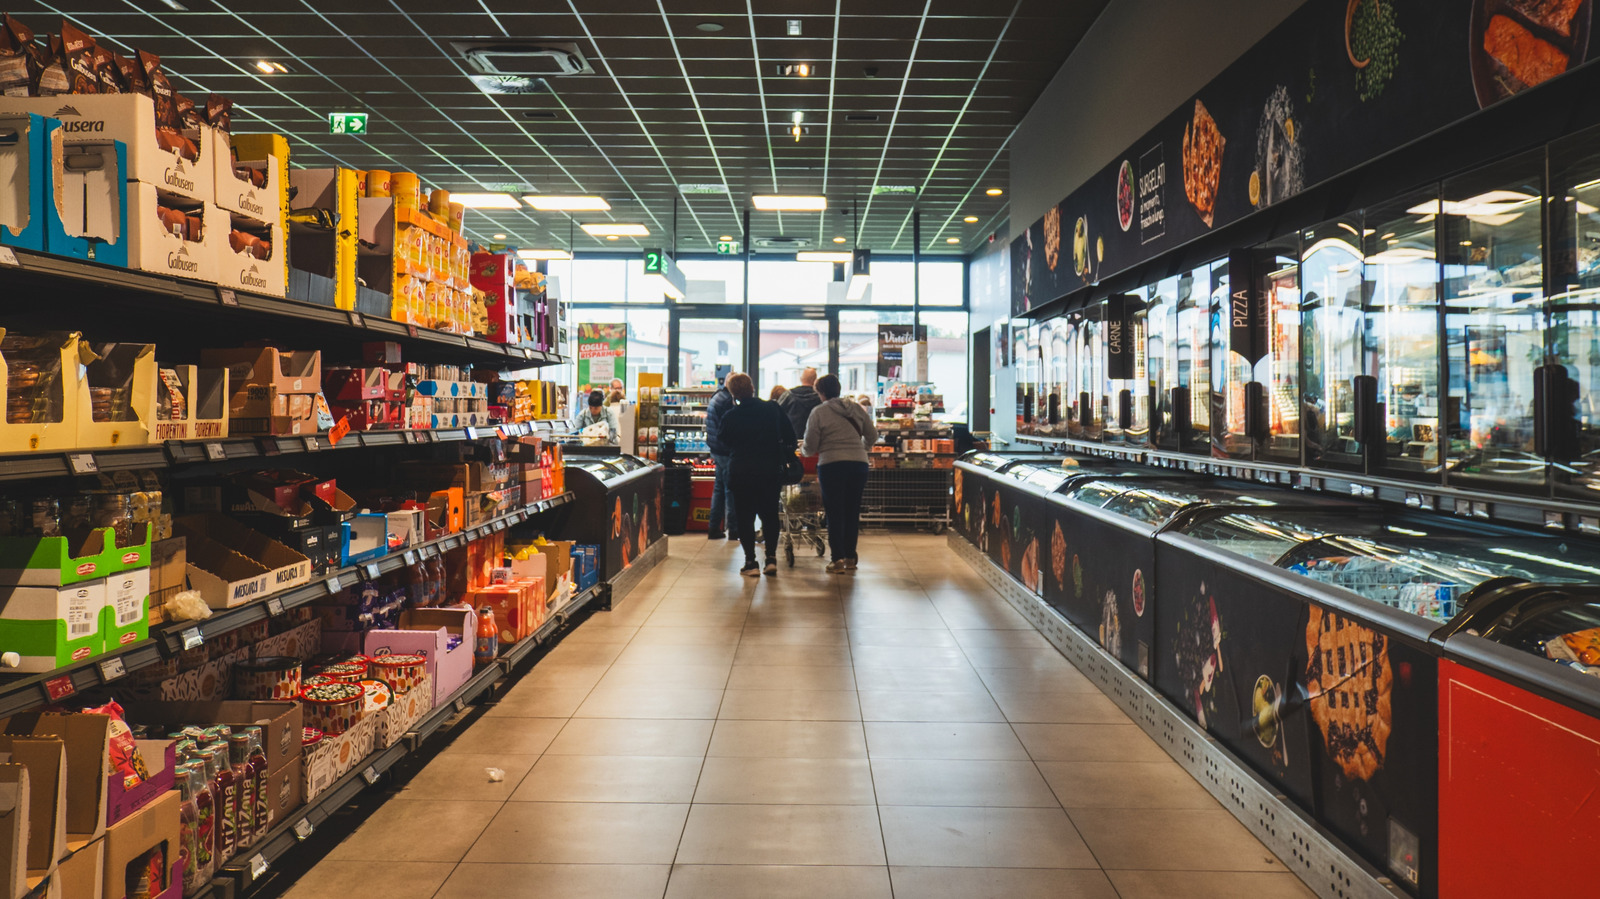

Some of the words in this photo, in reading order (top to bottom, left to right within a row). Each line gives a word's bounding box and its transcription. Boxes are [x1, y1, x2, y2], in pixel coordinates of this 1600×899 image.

[62, 119, 105, 133] usera
[164, 166, 195, 193] Galbusera
[1139, 162, 1166, 198] SURGELATI
[238, 193, 264, 216] Galbusera
[167, 251, 198, 273] Galbusera
[646, 253, 658, 270] 2
[857, 255, 865, 270] 1
[239, 268, 267, 289] Galbusera
[1232, 289, 1248, 328] PIZZA
[580, 343, 604, 351] COGLI
[1110, 320, 1122, 355] CARNE
[156, 423, 188, 439] FIORENTINI
[195, 422, 222, 438] FIORENTINI
[237, 778, 252, 848] AriZona
[256, 769, 268, 838] AriZona
[221, 785, 236, 859] AriZona
